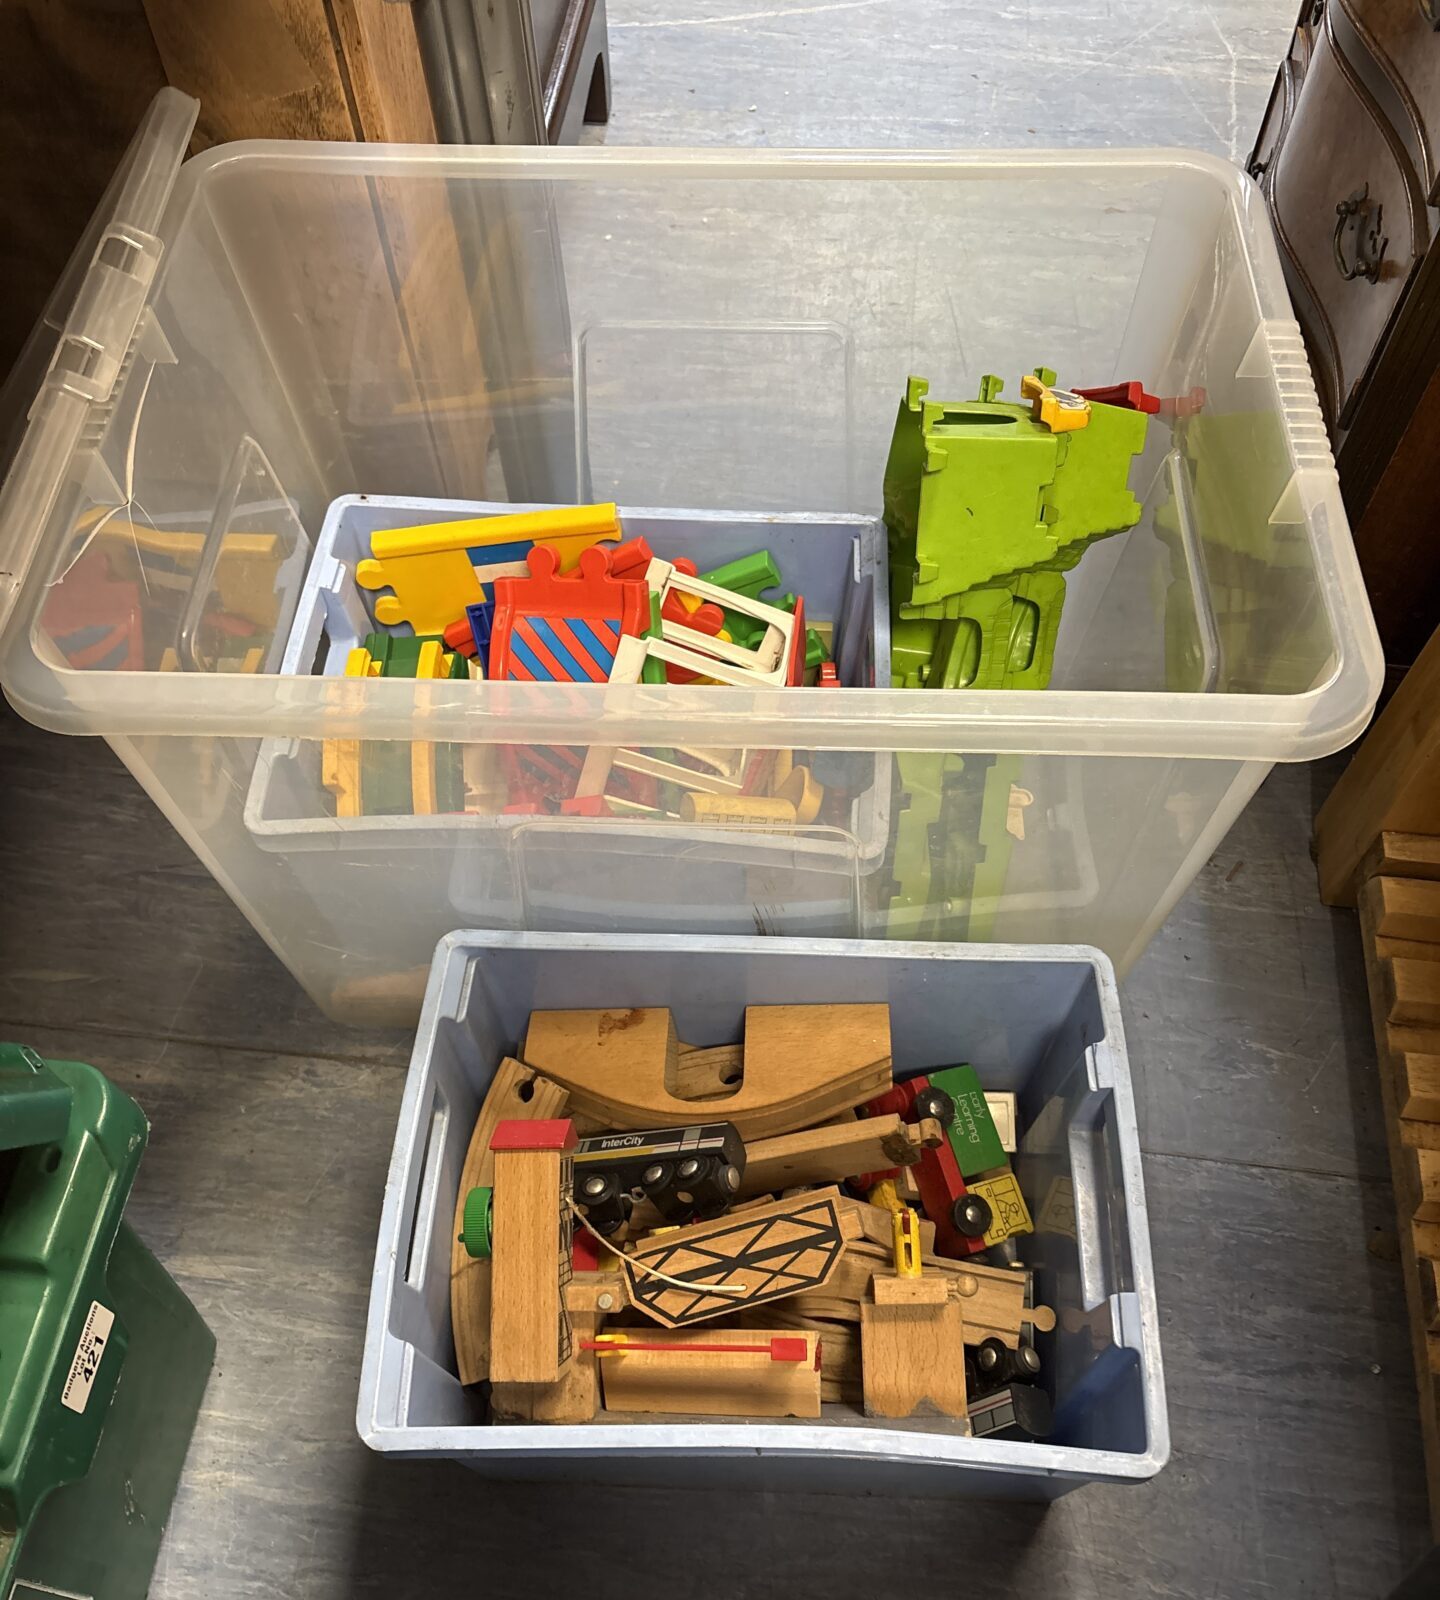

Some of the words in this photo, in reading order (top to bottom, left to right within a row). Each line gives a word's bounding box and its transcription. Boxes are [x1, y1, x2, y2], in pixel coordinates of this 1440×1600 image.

[601, 1135, 645, 1149] InterCity
[958, 1093, 980, 1143] Learning
[64, 1354, 82, 1400] Badgers
[80, 1304, 98, 1351] Auctions
[77, 1358, 86, 1376] Lot
[83, 1336, 104, 1384] 421
